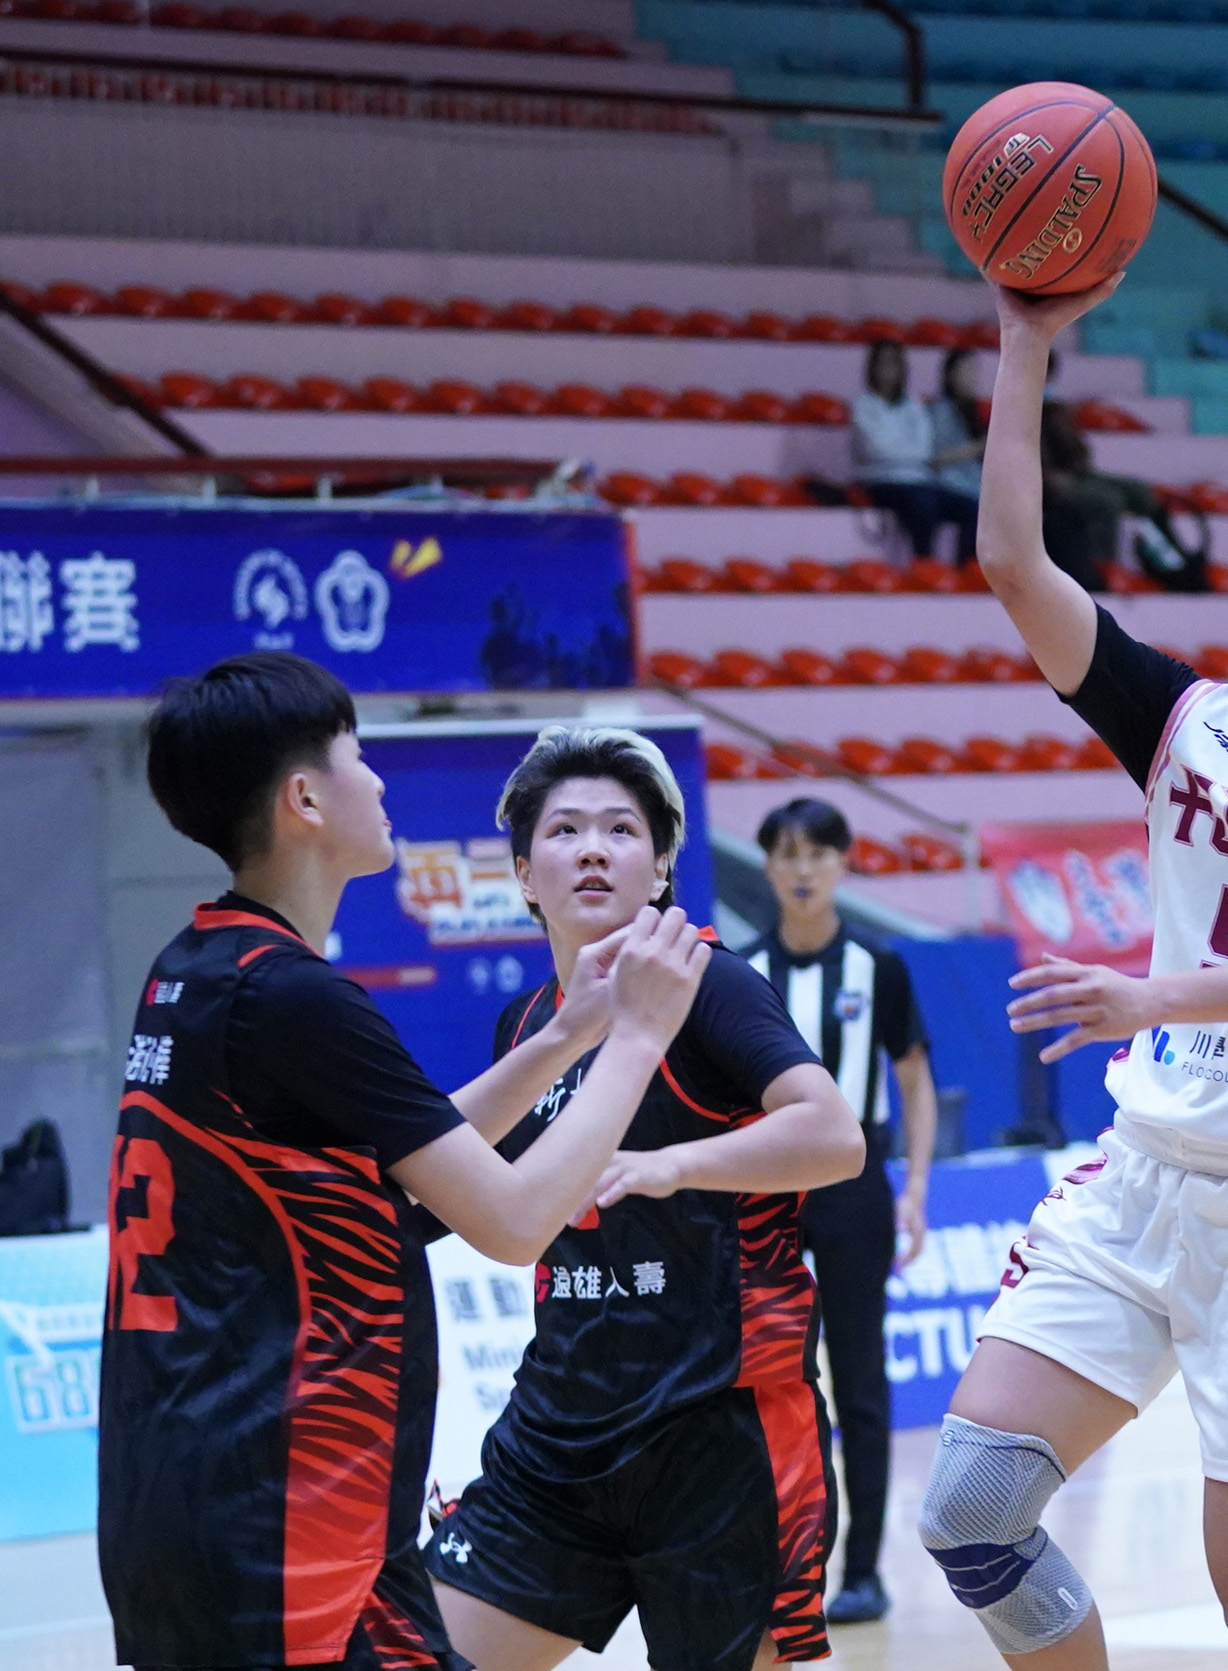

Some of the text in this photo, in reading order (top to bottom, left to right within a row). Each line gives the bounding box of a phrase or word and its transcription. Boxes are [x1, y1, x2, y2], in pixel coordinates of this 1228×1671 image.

[969, 134, 1055, 244] LEGACY
[998, 162, 1102, 280] SPALDING
[551, 1261, 667, 1300] 遠雄人壽
